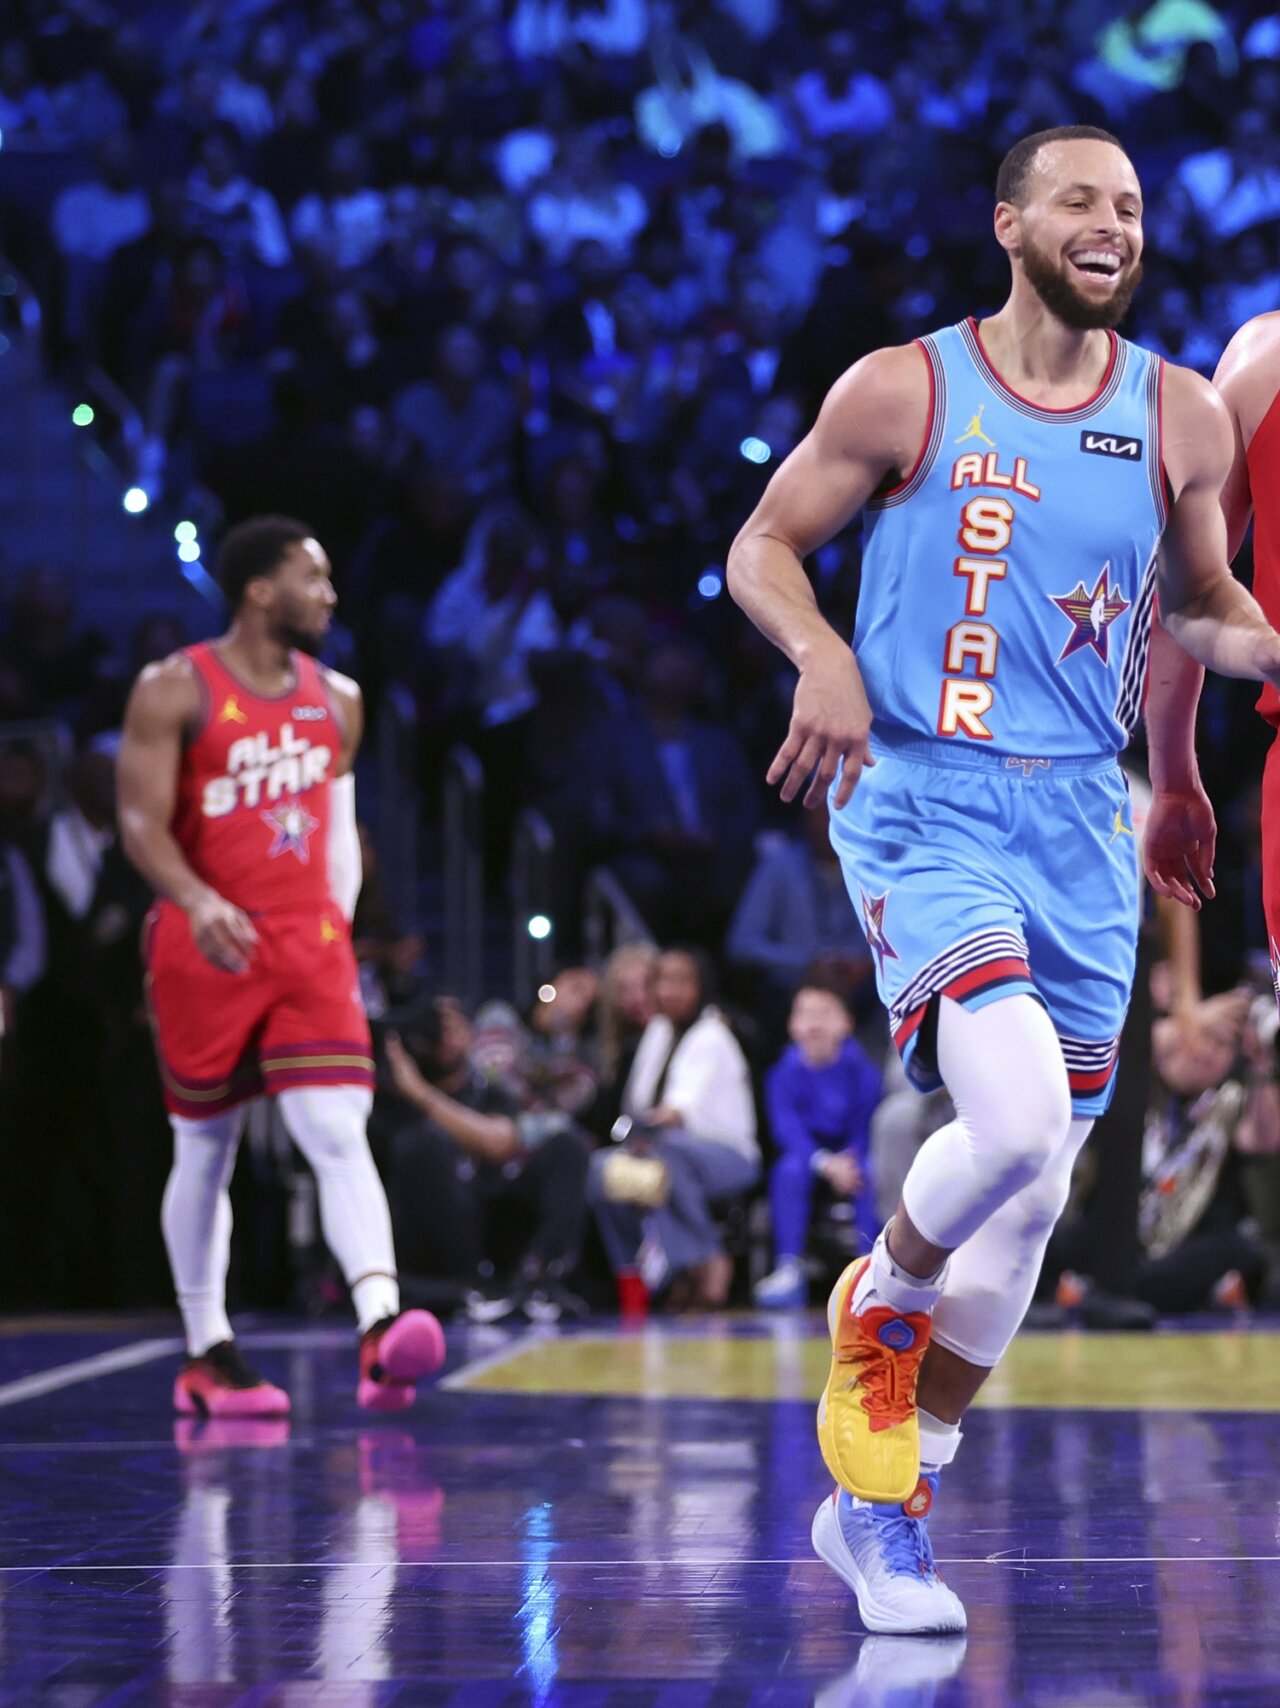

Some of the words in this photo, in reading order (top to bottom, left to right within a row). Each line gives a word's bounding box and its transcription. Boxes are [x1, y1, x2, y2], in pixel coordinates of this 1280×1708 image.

[1086, 435, 1138, 456] KIA
[951, 451, 1041, 502] ALL
[937, 495, 1015, 740] STAR
[227, 722, 311, 775] ALL
[202, 745, 331, 819] STAR
